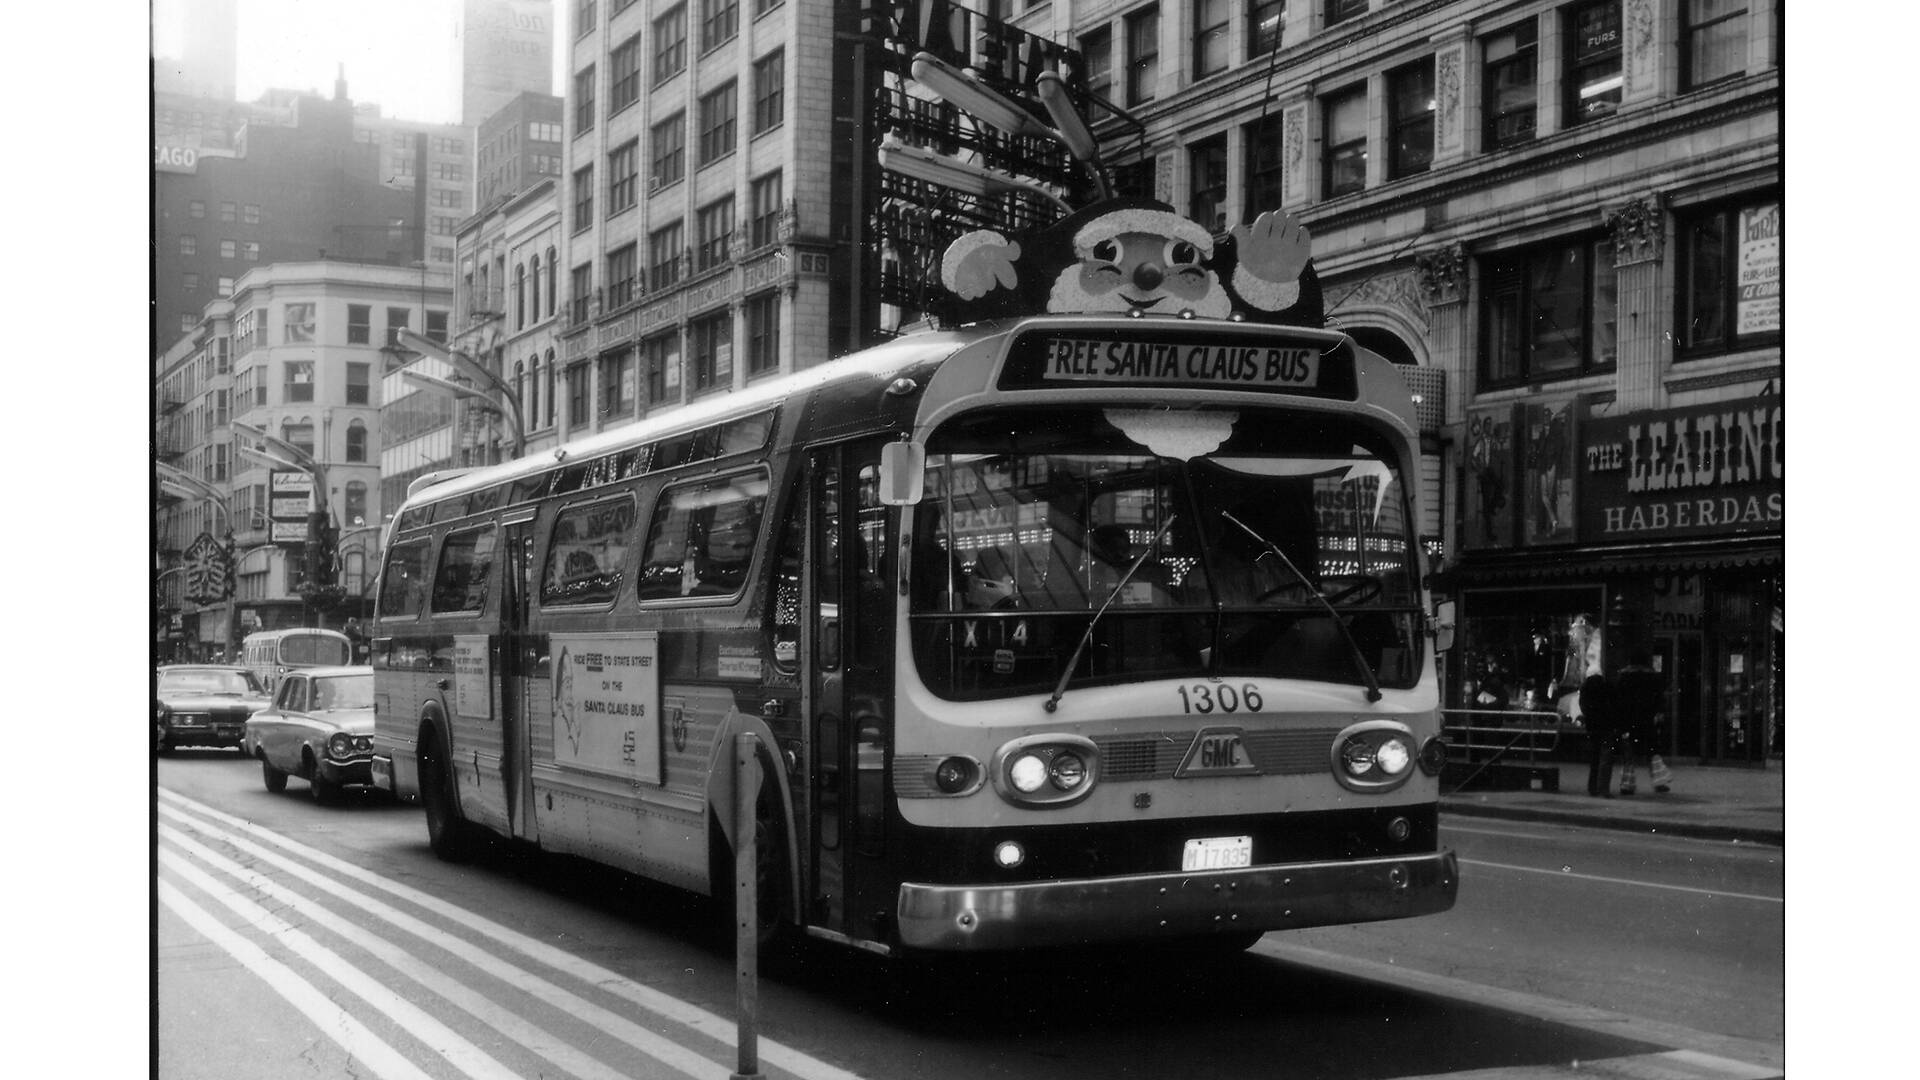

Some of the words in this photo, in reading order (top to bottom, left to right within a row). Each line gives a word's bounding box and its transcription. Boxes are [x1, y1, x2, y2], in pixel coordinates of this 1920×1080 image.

[1587, 30, 1616, 48] FURS
[155, 146, 195, 167] AGO
[1046, 338, 1098, 376] FREE
[1105, 341, 1180, 378] SANTA
[1185, 345, 1259, 382] CLAUS
[1264, 348, 1311, 383] BUS
[1587, 443, 1622, 471] THE
[1604, 493, 1782, 533] HABERDAS
[573, 654, 586, 665] RIDE
[586, 653, 603, 665] FREE
[604, 655, 612, 665] TO
[613, 655, 630, 666] STATE
[631, 655, 653, 667] STREET
[602, 681, 611, 690] ON
[612, 681, 623, 691] THE
[584, 700, 606, 713] SANTA
[607, 702, 629, 715] CLAUS
[631, 704, 645, 717] BUS
[1177, 683, 1263, 714] 1306
[1201, 737, 1241, 768] GMC
[1186, 849, 1198, 869] M
